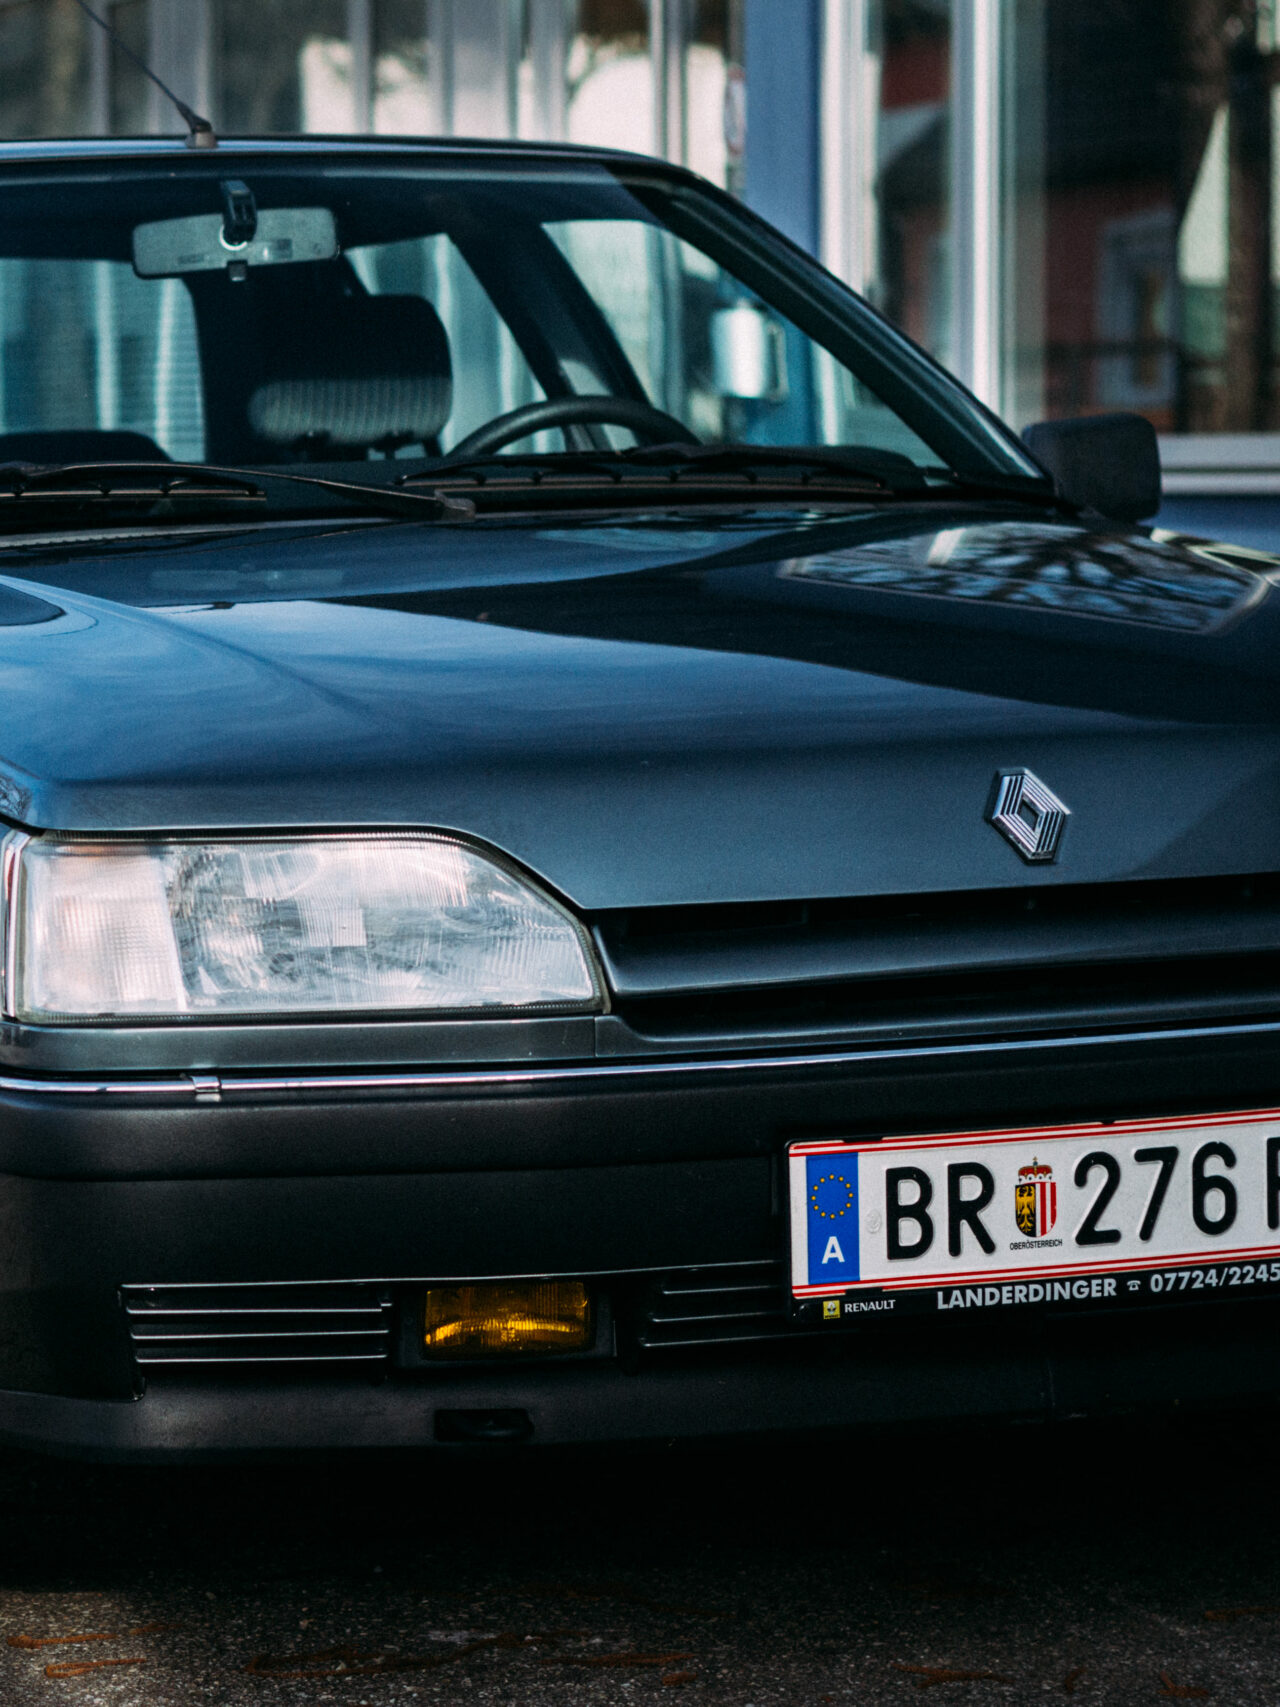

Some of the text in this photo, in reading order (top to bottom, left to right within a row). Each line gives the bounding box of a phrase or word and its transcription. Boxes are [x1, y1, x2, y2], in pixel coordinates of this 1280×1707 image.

[886, 1162, 996, 1260] BR
[821, 1236, 846, 1264] A
[1009, 1239, 1063, 1250] OBERÖSTERREICH
[937, 1263, 1280, 1310] LANDERDINGER 07724/2245
[844, 1300, 896, 1313] RENAULT
